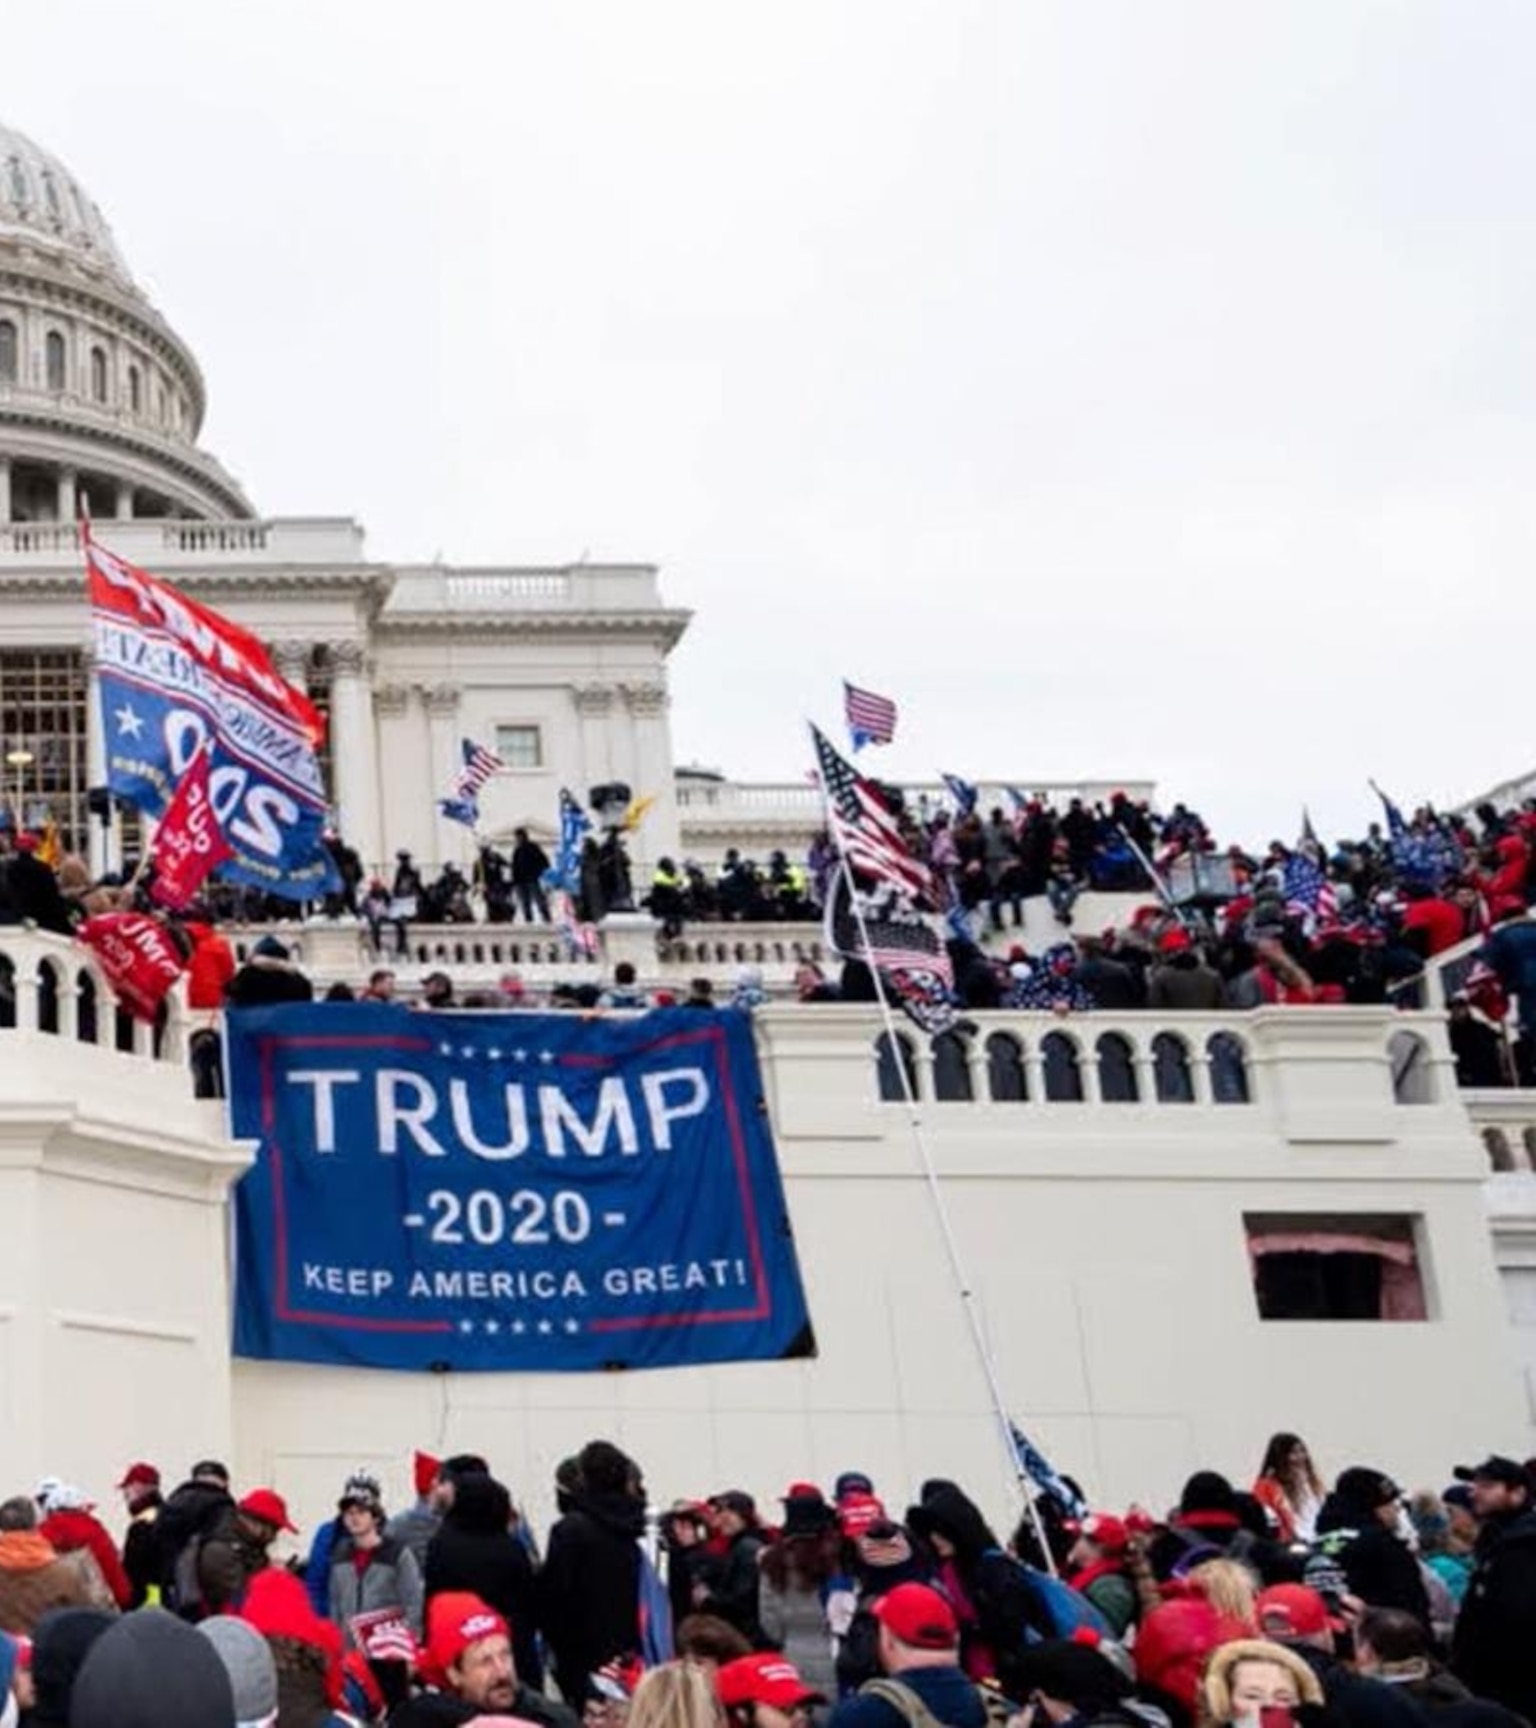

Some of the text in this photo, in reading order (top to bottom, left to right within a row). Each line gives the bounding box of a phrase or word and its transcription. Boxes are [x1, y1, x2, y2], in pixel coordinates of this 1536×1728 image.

[286, 1066, 711, 1160] TRUMP
[303, 1258, 747, 1300] KEEP AMERICA GREAT!
